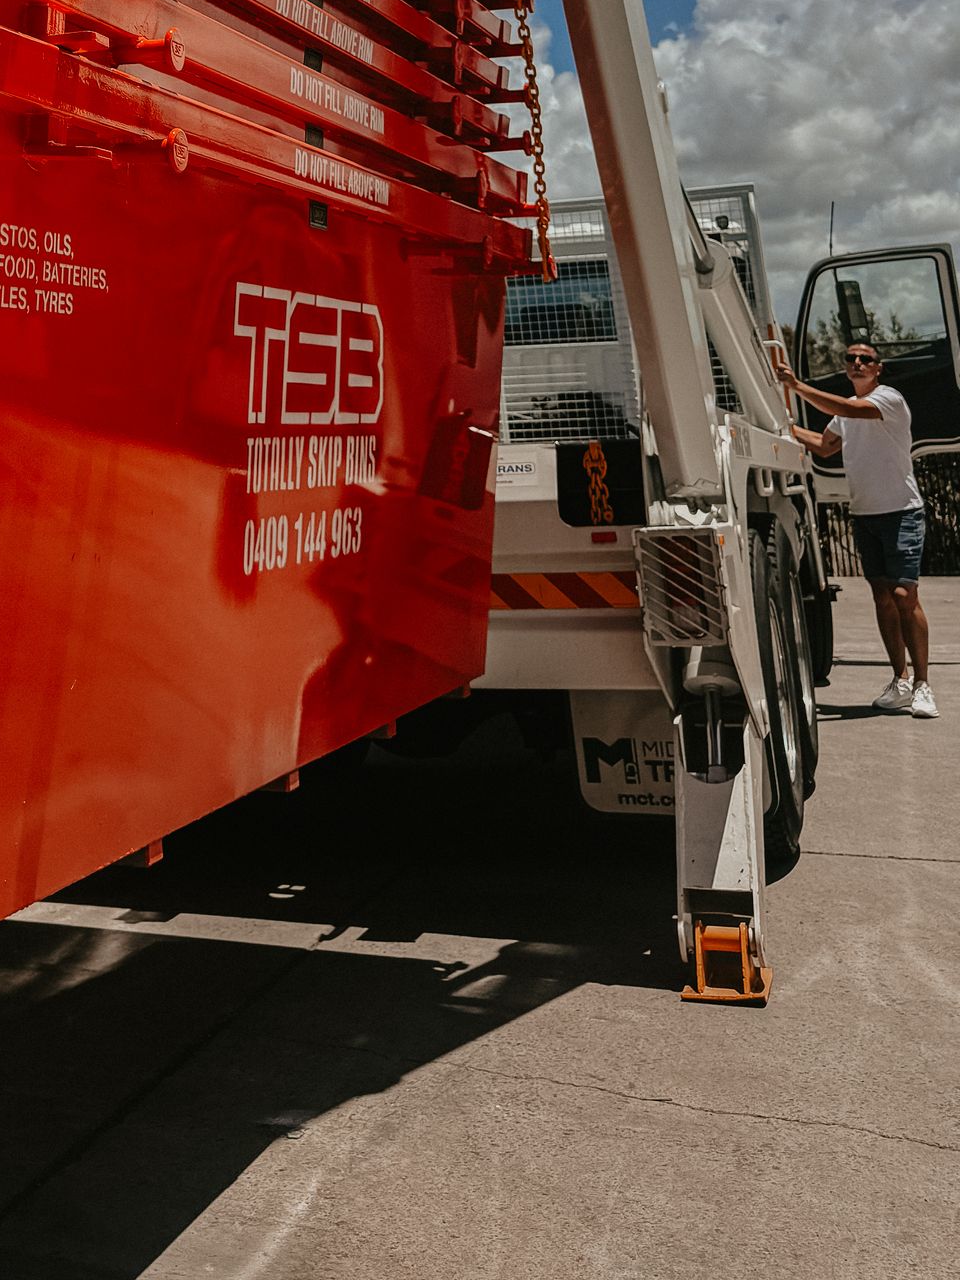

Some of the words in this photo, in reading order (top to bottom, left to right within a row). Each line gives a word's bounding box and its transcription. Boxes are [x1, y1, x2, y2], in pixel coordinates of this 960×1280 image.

[312, 7, 329, 40] FILL
[330, 20, 358, 56] ABOVE
[357, 38, 374, 67] RIM
[290, 67, 304, 97] DO
[305, 74, 323, 106] NOT
[325, 85, 342, 115] FILL
[343, 95, 368, 128] ABOVE
[370, 107, 385, 135] RIM
[294, 148, 308, 178] DO
[310, 154, 327, 185] NOT
[329, 161, 346, 192] FILL
[347, 169, 373, 201] ABOVE
[375, 179, 389, 207] RIM
[44, 231, 74, 260] OILS,
[35, 289, 73, 315] TYRES
[42, 261, 109, 293] BATTERIES,
[234, 281, 384, 425] TSB
[247, 436, 305, 494] TOTALLY
[307, 435, 343, 489] SKIP
[345, 435, 377, 486] BINS
[243, 514, 289, 576] 0409
[294, 510, 326, 564] 144
[331, 507, 362, 558] 963
